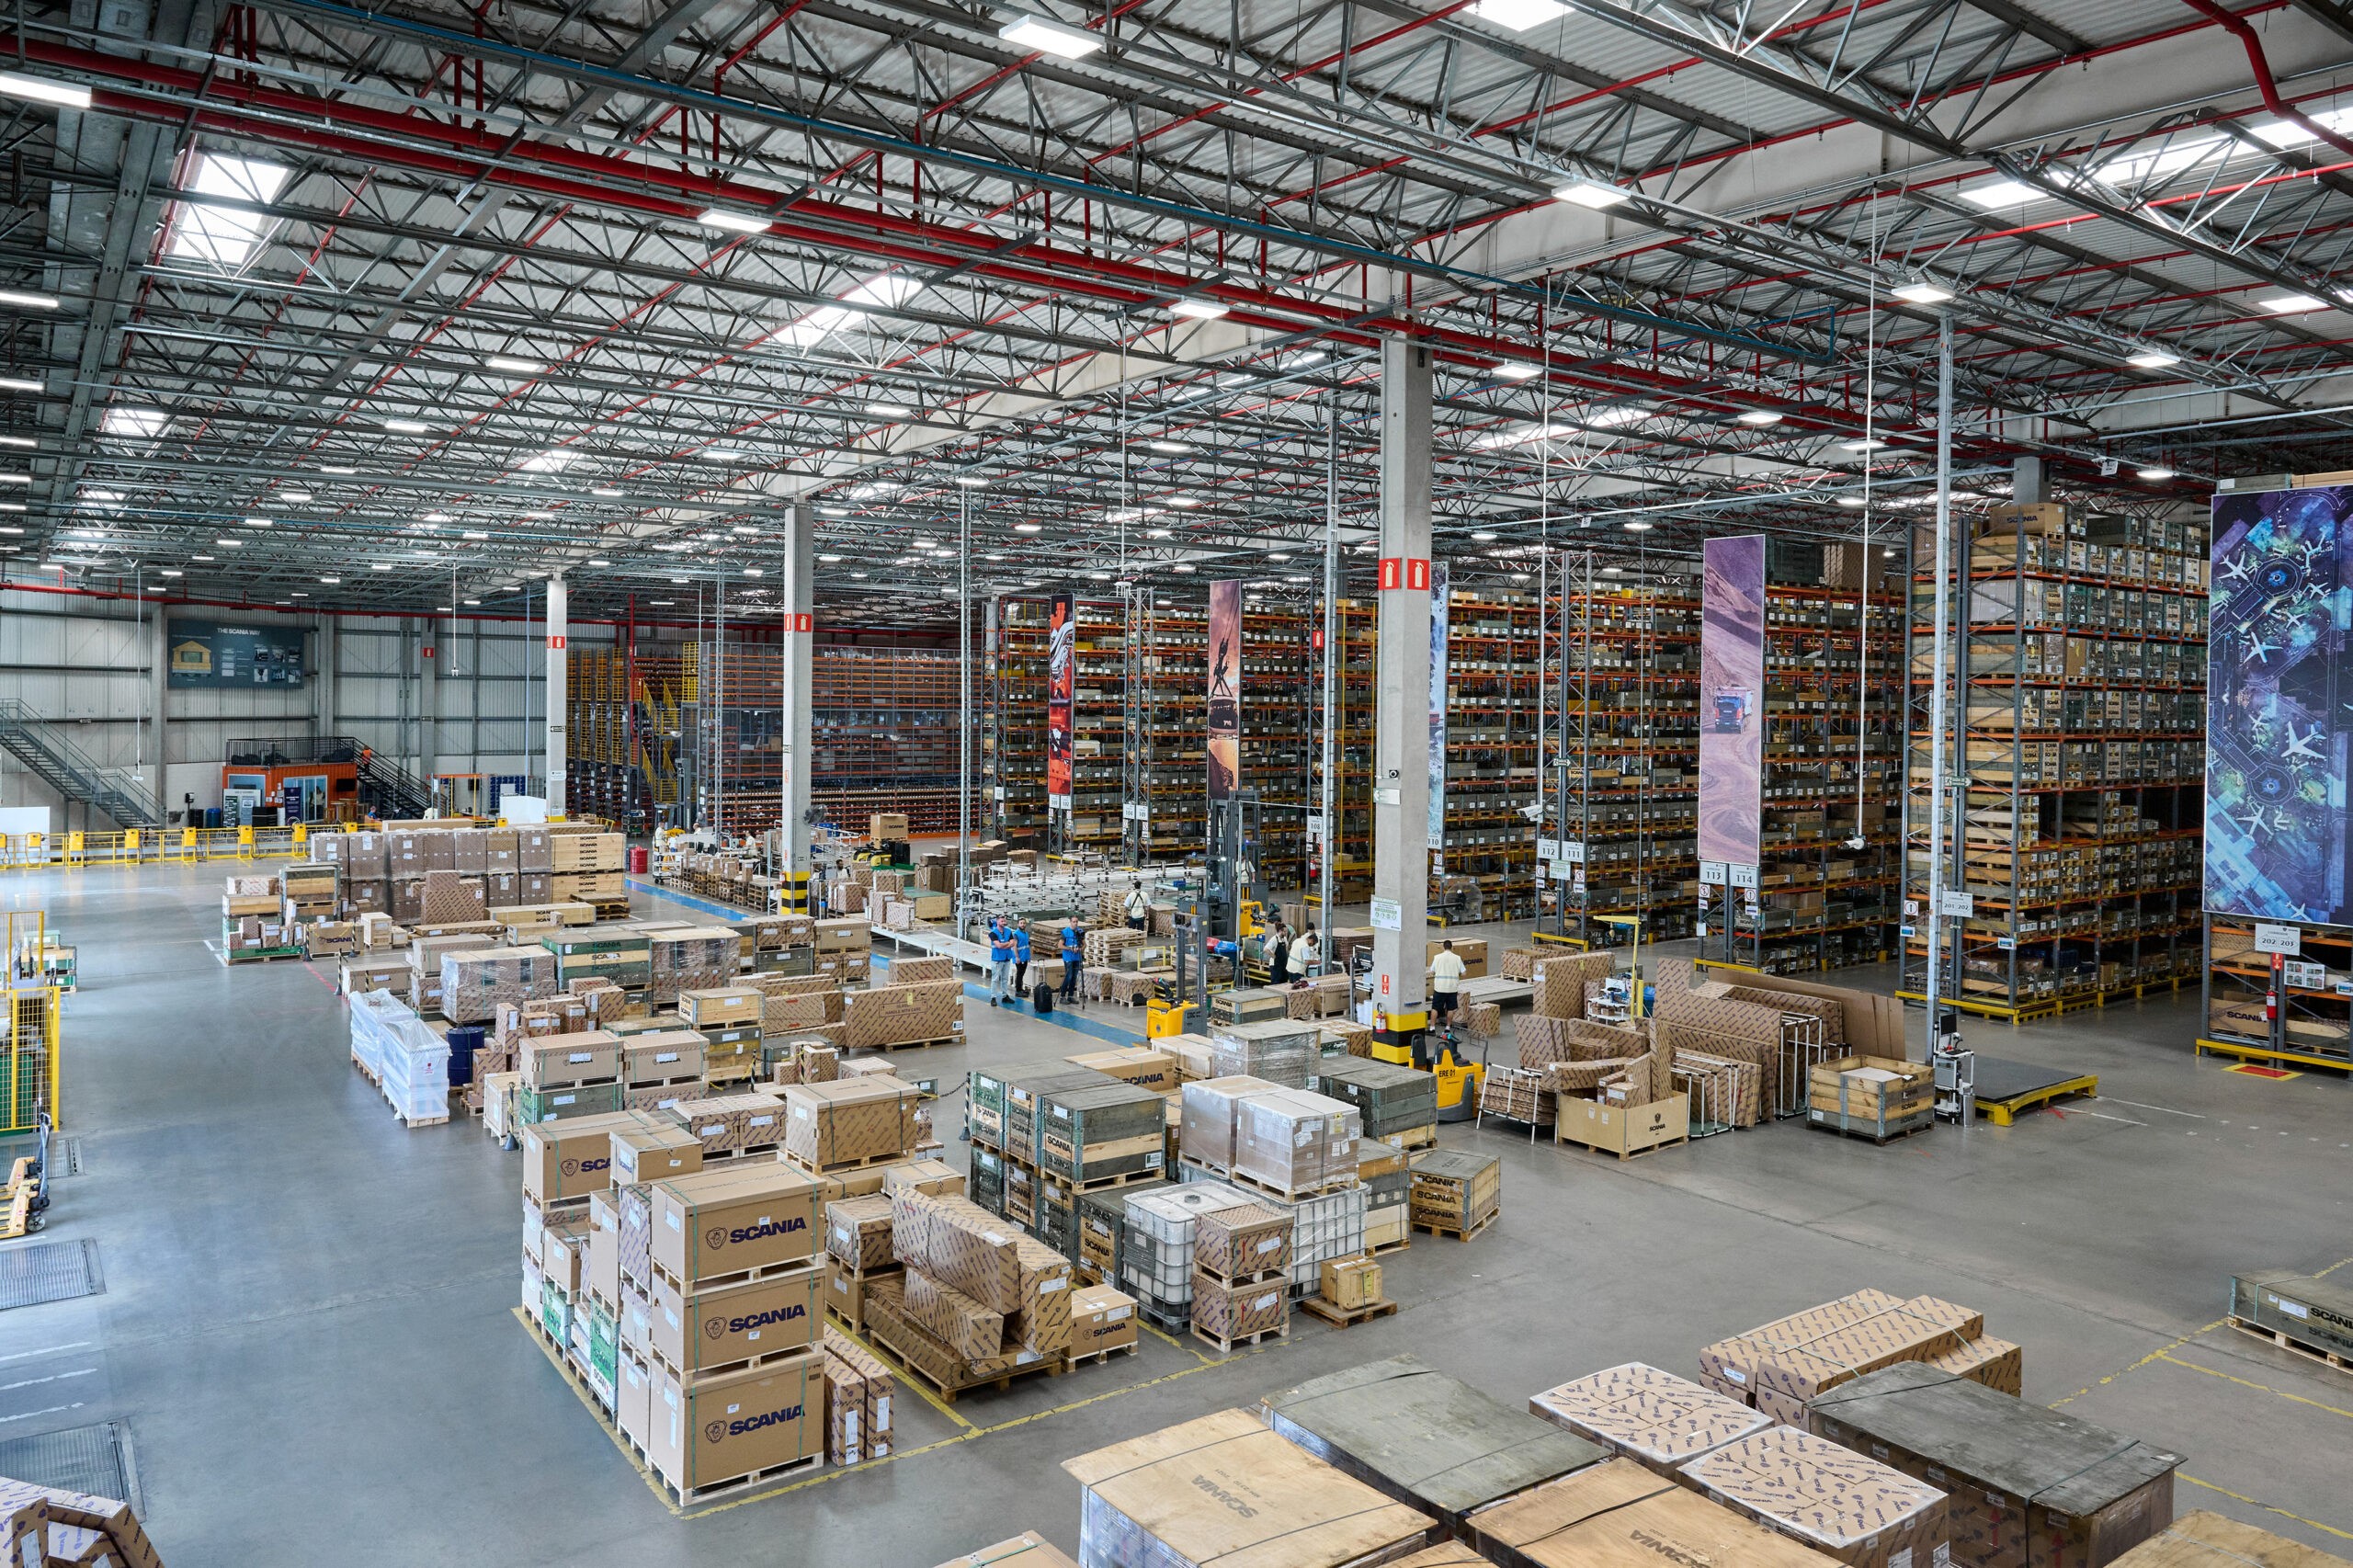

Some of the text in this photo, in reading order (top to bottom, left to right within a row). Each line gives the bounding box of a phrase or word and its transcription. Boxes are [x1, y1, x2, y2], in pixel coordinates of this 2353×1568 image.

[1542, 847, 1555, 856] 112
[1568, 850, 1580, 858] 111
[1706, 871, 1722, 880] 113
[1736, 875, 1752, 883] 114
[591, 952, 620, 960] SCAA
[1438, 1068, 1456, 1077] ERE 01
[977, 1105, 997, 1119] SANIA
[1011, 1105, 1032, 1119] SCANIA
[1901, 1101, 1918, 1111] SCANIA
[1011, 1121, 1032, 1136] SCANIA
[1046, 1117, 1071, 1134] SCANIA
[1648, 1123, 1666, 1132] SCANIA
[1047, 1135, 1071, 1153] SCANIA
[581, 1158, 611, 1173] SCA
[1009, 1183, 1031, 1200] SCANIA
[1416, 1190, 1457, 1205] SCANIA
[1009, 1200, 1031, 1217] SCANIA
[1416, 1207, 1456, 1220] SCANIA
[730, 1217, 807, 1244] SCANIA
[1085, 1238, 1109, 1257] SCANIA
[595, 1305, 611, 1327] SCANIA
[729, 1304, 806, 1333] SCANIA
[2310, 1307, 2353, 1330] SCANI
[1093, 1322, 1126, 1337] SCANIA
[2308, 1325, 2353, 1348] SCANI
[729, 1404, 806, 1436] SCANIA
[1191, 1474, 1259, 1518] SCANIA
